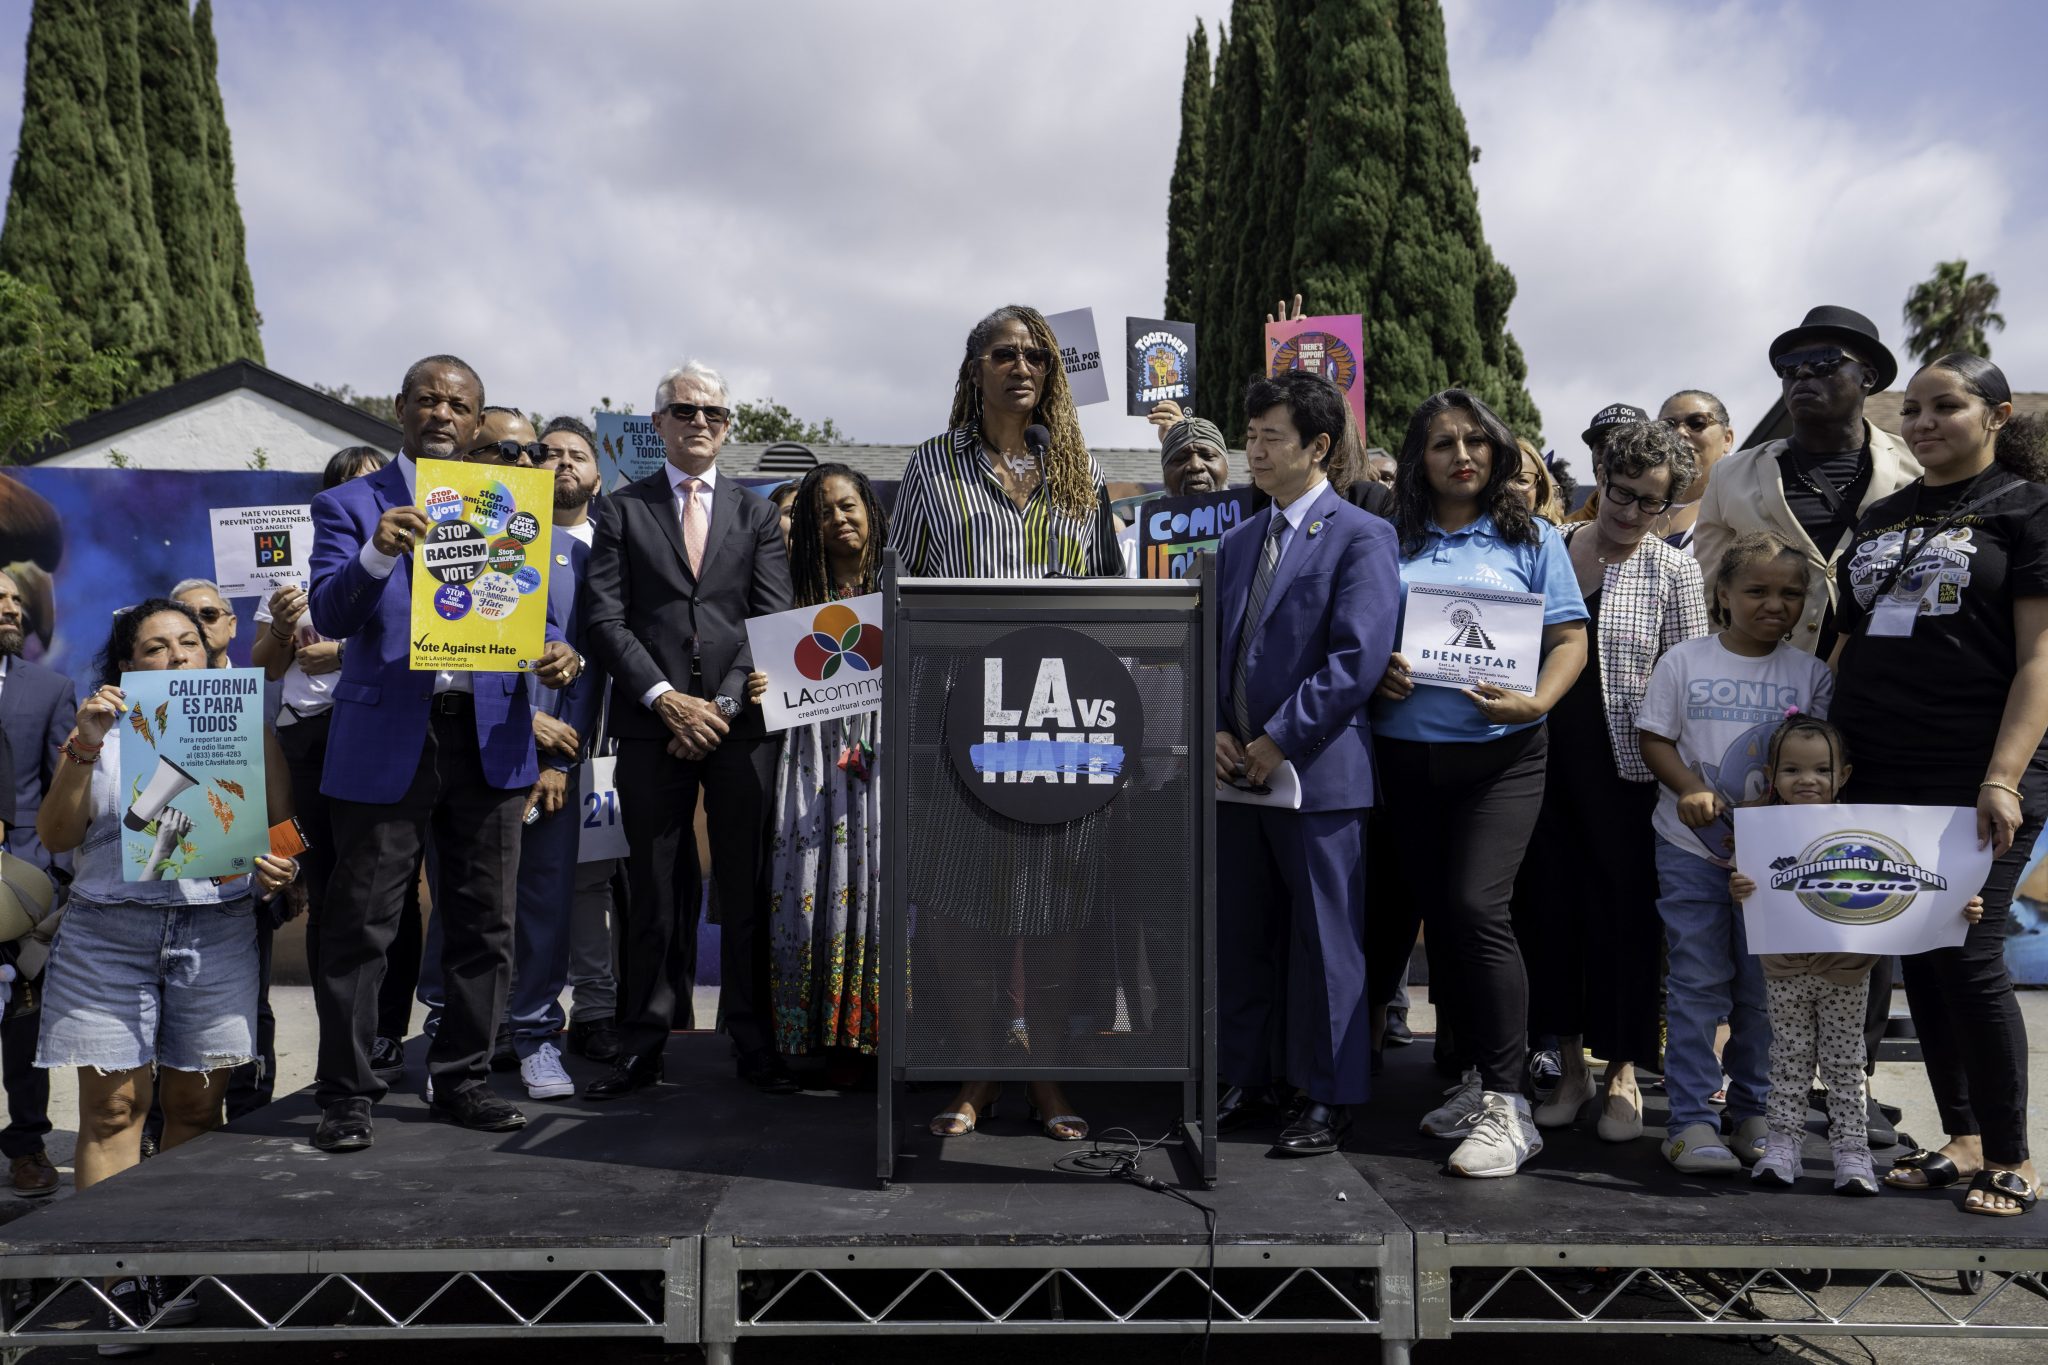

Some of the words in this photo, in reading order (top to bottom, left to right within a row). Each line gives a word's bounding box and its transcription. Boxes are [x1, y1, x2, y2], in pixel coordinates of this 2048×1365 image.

[1134, 331, 1189, 357] TOGETHER
[1300, 343, 1323, 351] THERE'S
[1082, 351, 1100, 362] POR
[1299, 350, 1325, 359] SUPPORT
[1303, 358, 1320, 366] WHEN
[1142, 384, 1184, 402] HATE
[1598, 407, 1618, 419] MAKE
[632, 434, 644, 446] ES
[636, 446, 667, 459] TODOS
[426, 494, 459, 506] SEXISM
[431, 489, 453, 499] STOP
[479, 489, 504, 503] stop
[462, 494, 515, 515] anti-LGBTQ+
[241, 510, 261, 518] HATE
[262, 509, 301, 517] VIOLENCE
[474, 505, 499, 519] hate
[220, 518, 269, 526] PREVENTION
[470, 512, 500, 529] VOTE
[513, 520, 536, 529] ANTI-
[516, 515, 535, 523] STOP
[437, 524, 471, 541] STOP
[509, 523, 537, 536] BLACK
[425, 543, 487, 562] RACISM
[498, 548, 515, 557] Stop
[1921, 547, 1969, 571] Action
[250, 570, 302, 579] #ALL4ONELA
[441, 565, 475, 582] VOTE
[445, 587, 466, 598] STOP
[483, 581, 507, 593] Stop
[472, 589, 519, 604] ANTI-IMMIGRANT
[479, 597, 504, 610] Hate
[1454, 599, 1483, 618] ANNIVERSARY
[481, 606, 501, 617] VOTE
[413, 632, 440, 653] Vote
[441, 642, 486, 655] Against
[489, 644, 517, 655] Hate
[1421, 649, 1517, 670] BIENESTAR
[169, 678, 258, 697] CALIFORNIA
[783, 677, 882, 709] LAcomm
[983, 657, 1077, 728] LA
[1688, 678, 1799, 711] SONIC
[182, 697, 200, 715] ES
[204, 697, 244, 714] PARA
[798, 707, 830, 719] creating
[831, 700, 860, 713] cultural
[861, 697, 882, 706] conn
[1690, 708, 1713, 718] THE
[188, 715, 238, 733] TODOS
[179, 736, 195, 744] Para
[195, 736, 223, 744] reportar
[192, 743, 201, 751] de
[202, 743, 216, 751] odio
[193, 751, 211, 760] (833)
[211, 751, 242, 759] 866-4283
[983, 731, 1115, 785] HATE
[205, 758, 248, 767] CAvsHate.org
[583, 790, 615, 829] 21
[1768, 855, 1798, 871] The
[1770, 857, 1879, 890] Community
[1881, 859, 1948, 891] Action
[1797, 880, 1918, 892] League
